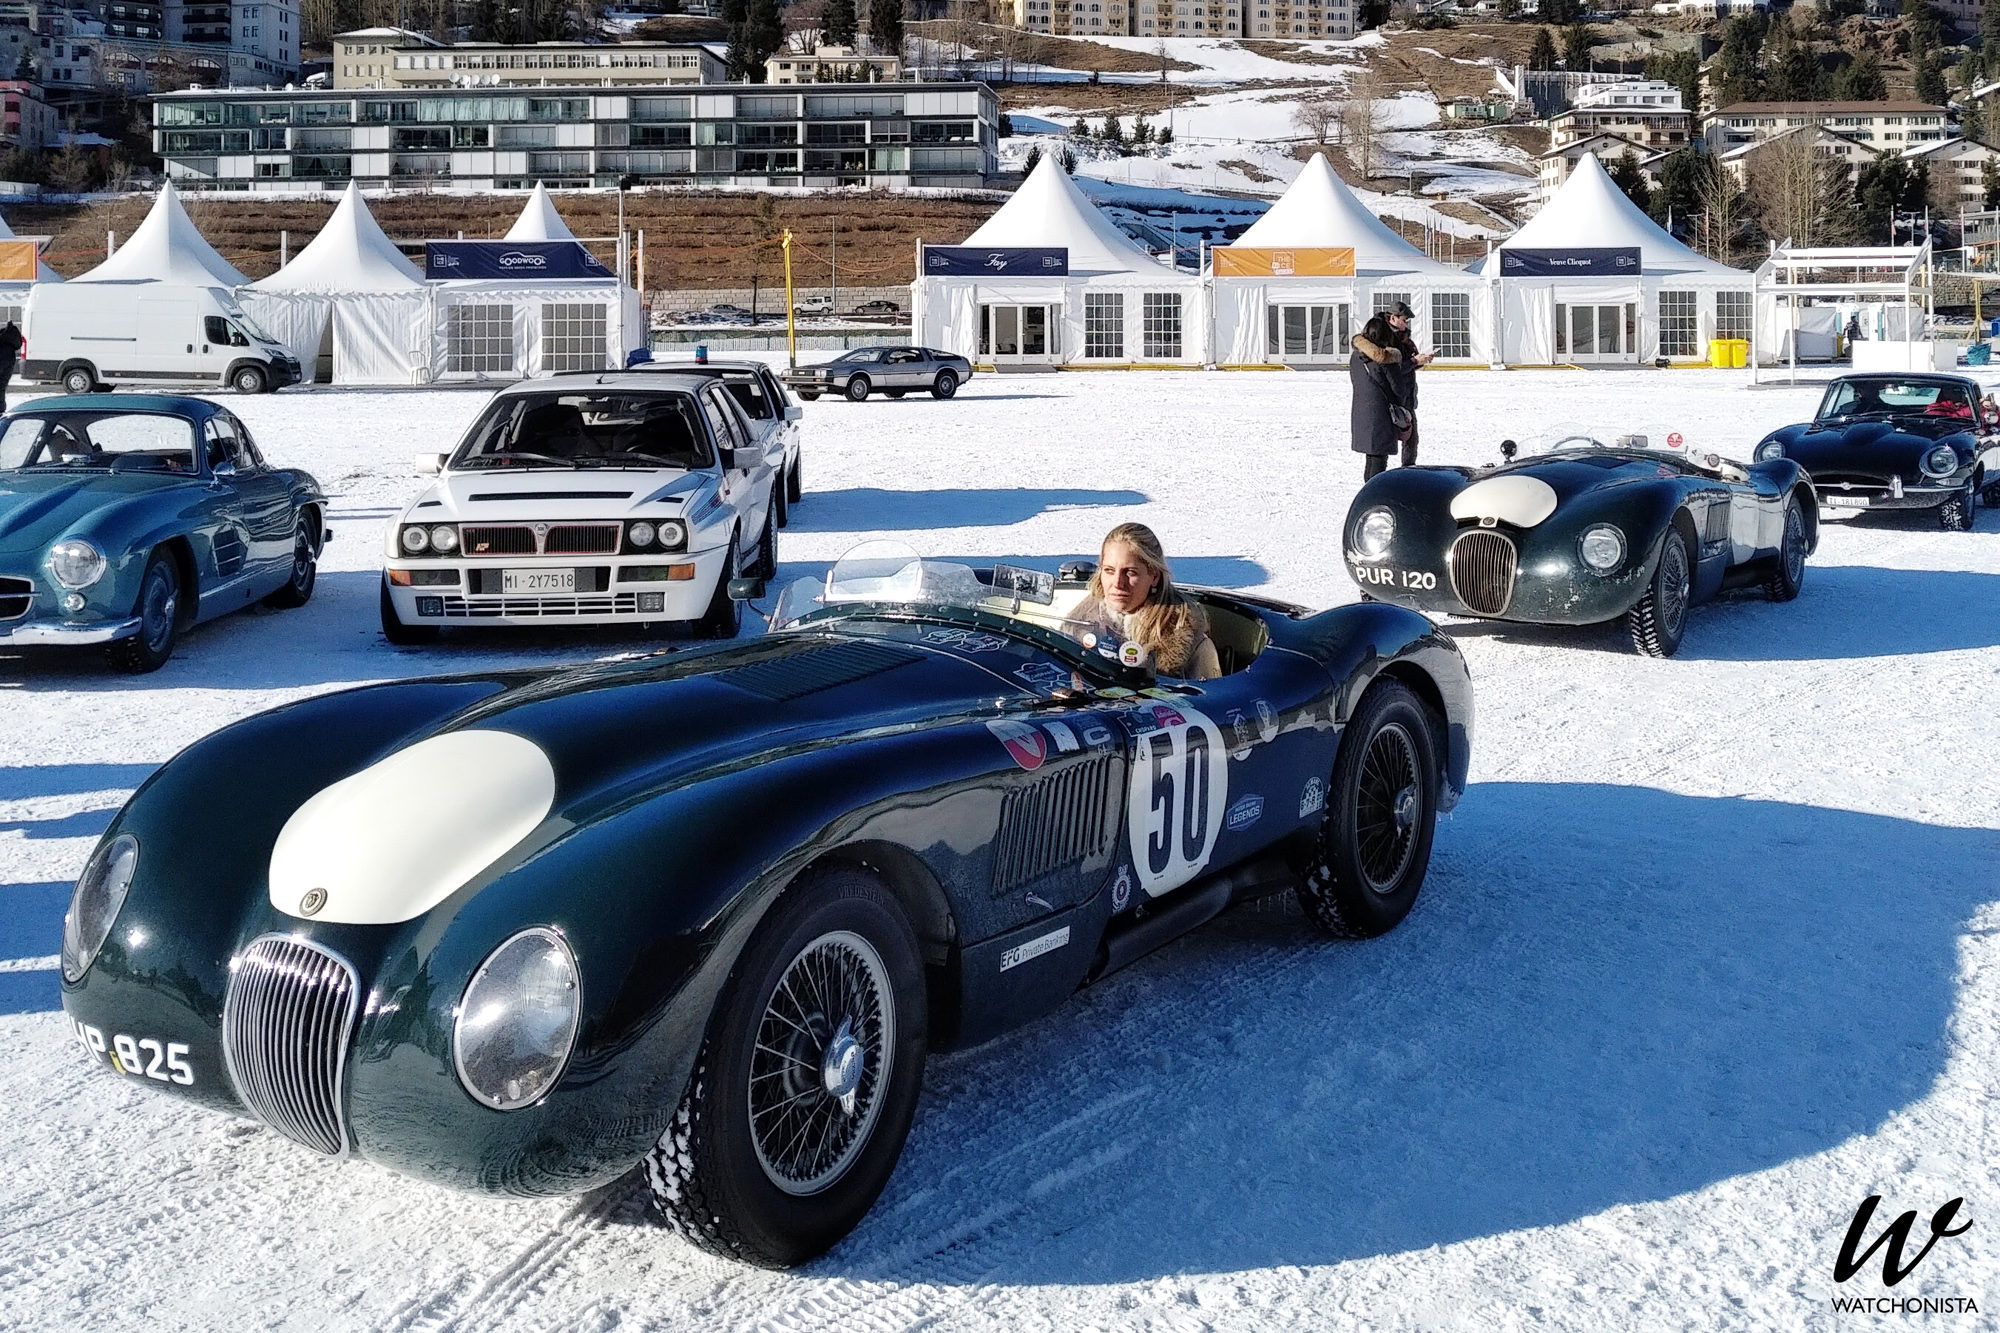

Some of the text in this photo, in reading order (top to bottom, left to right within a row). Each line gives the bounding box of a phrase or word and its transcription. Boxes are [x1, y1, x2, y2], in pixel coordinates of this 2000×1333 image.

[984, 253, 1008, 271] Fay
[1567, 258, 1591, 266] Clicquot
[1355, 567, 1437, 590] PUR 120
[1148, 725, 1210, 874] 50
[1229, 805, 1260, 825] LEGENDS
[1001, 933, 1069, 968] EFG Private Banking
[113, 1034, 194, 1086] 825
